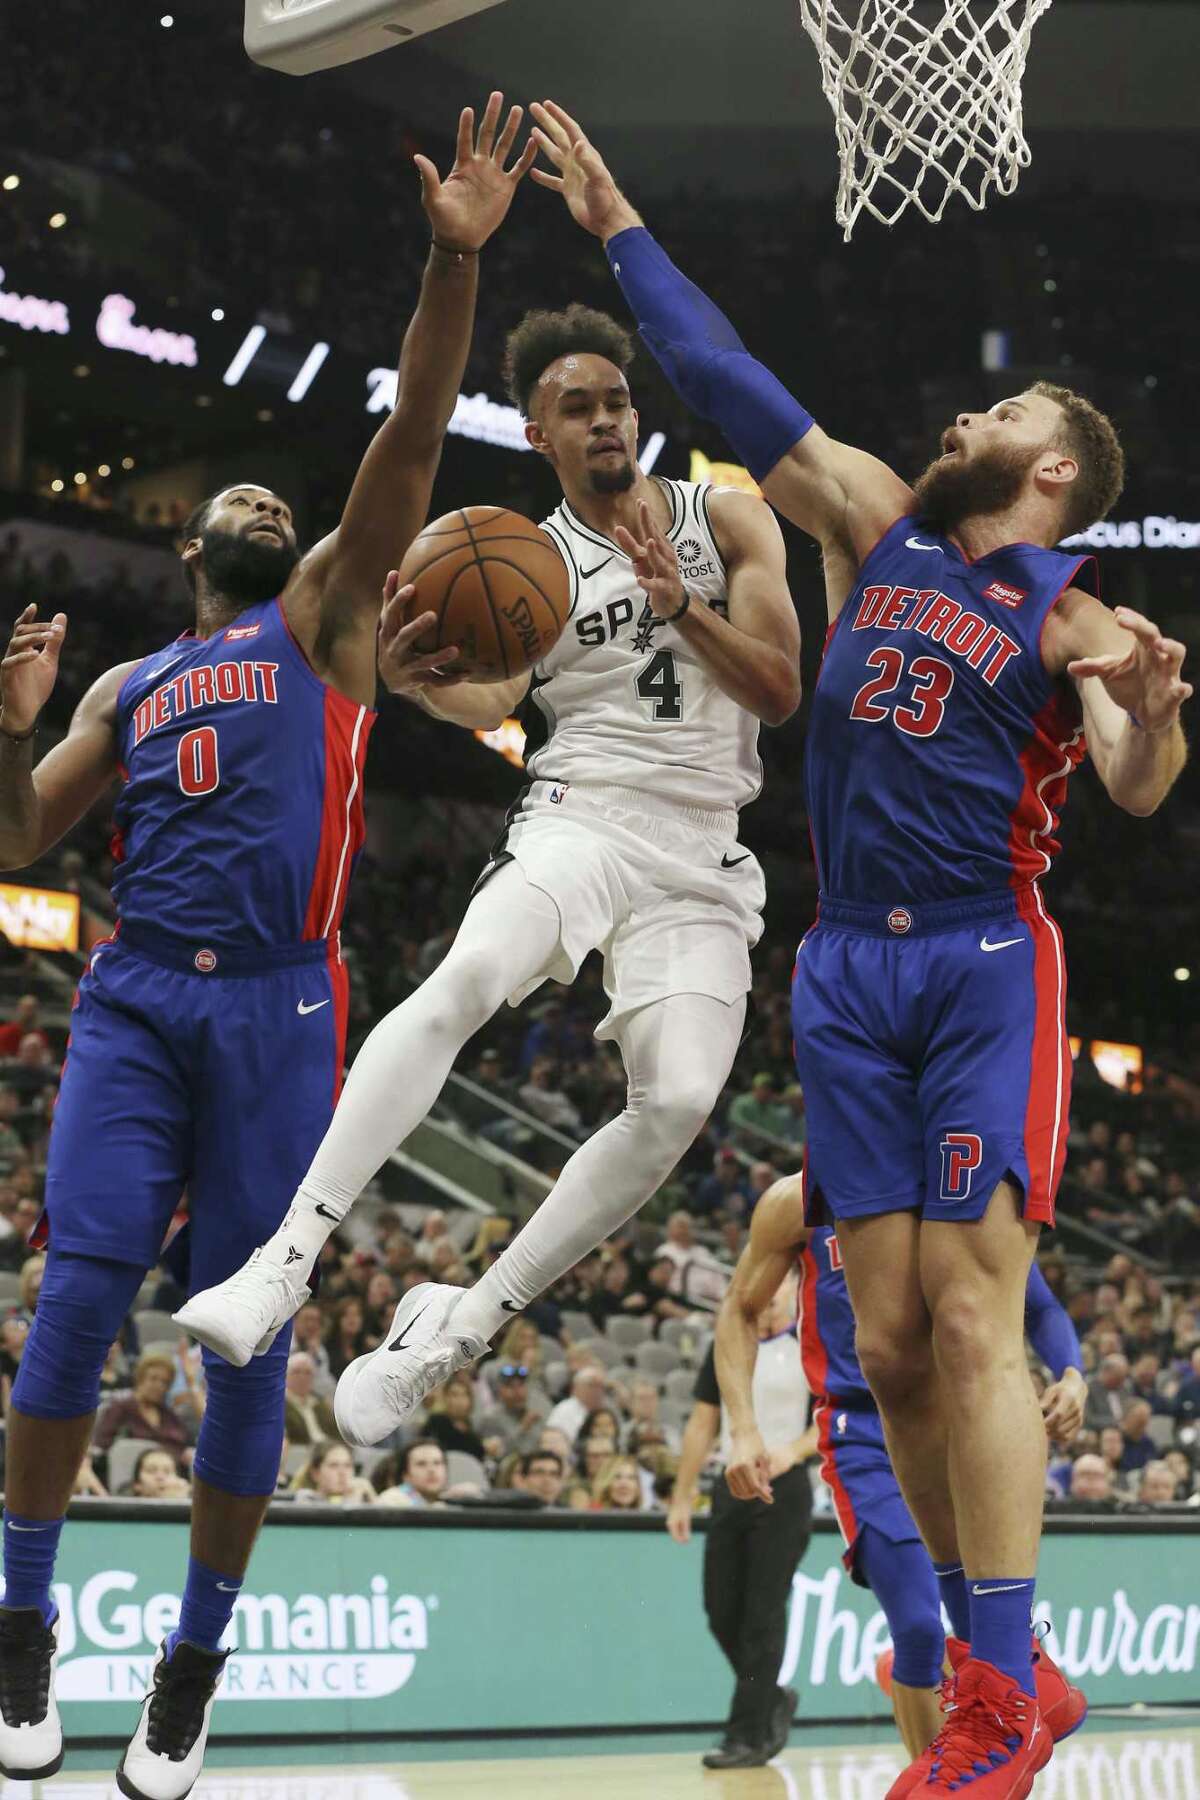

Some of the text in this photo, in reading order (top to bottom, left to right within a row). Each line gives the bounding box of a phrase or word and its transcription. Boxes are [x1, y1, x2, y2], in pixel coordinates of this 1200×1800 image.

[1058, 520, 1141, 548] cus
[989, 583, 1024, 601] Flagstar
[852, 585, 1023, 688] DETROIT
[132, 660, 280, 748] DETROIT
[633, 648, 684, 723] 4
[850, 646, 955, 738] 23
[176, 726, 220, 797] 0
[77, 1569, 428, 1651] Gemania
[106, 1661, 370, 1694] INRANCE
